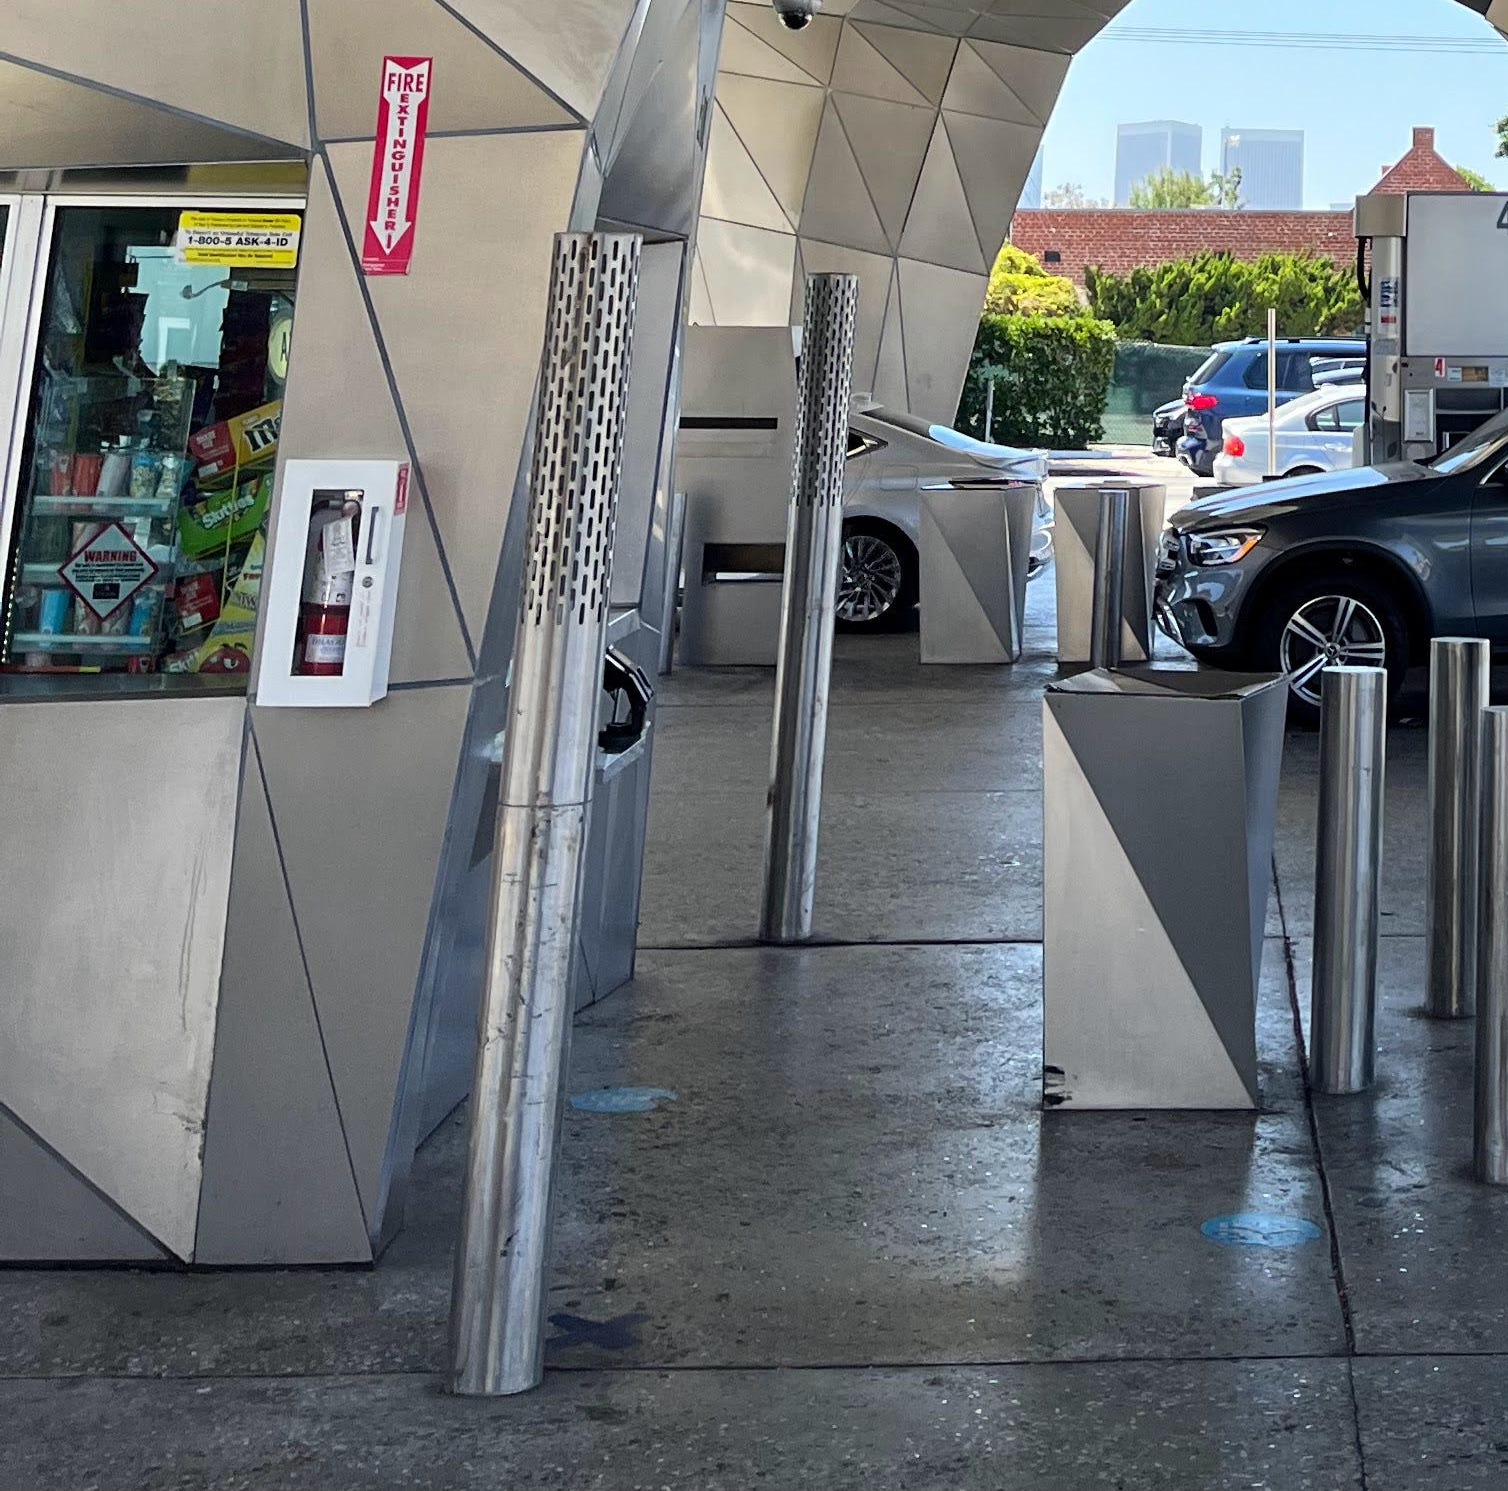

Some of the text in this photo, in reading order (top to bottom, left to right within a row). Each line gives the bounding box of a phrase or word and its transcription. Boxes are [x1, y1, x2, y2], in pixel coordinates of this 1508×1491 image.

[387, 72, 425, 93] FIRE
[187, 235, 289, 247] 1-800-5 ASK-4-ID
[1435, 358, 1444, 377] 4
[84, 550, 137, 562] WARNING
